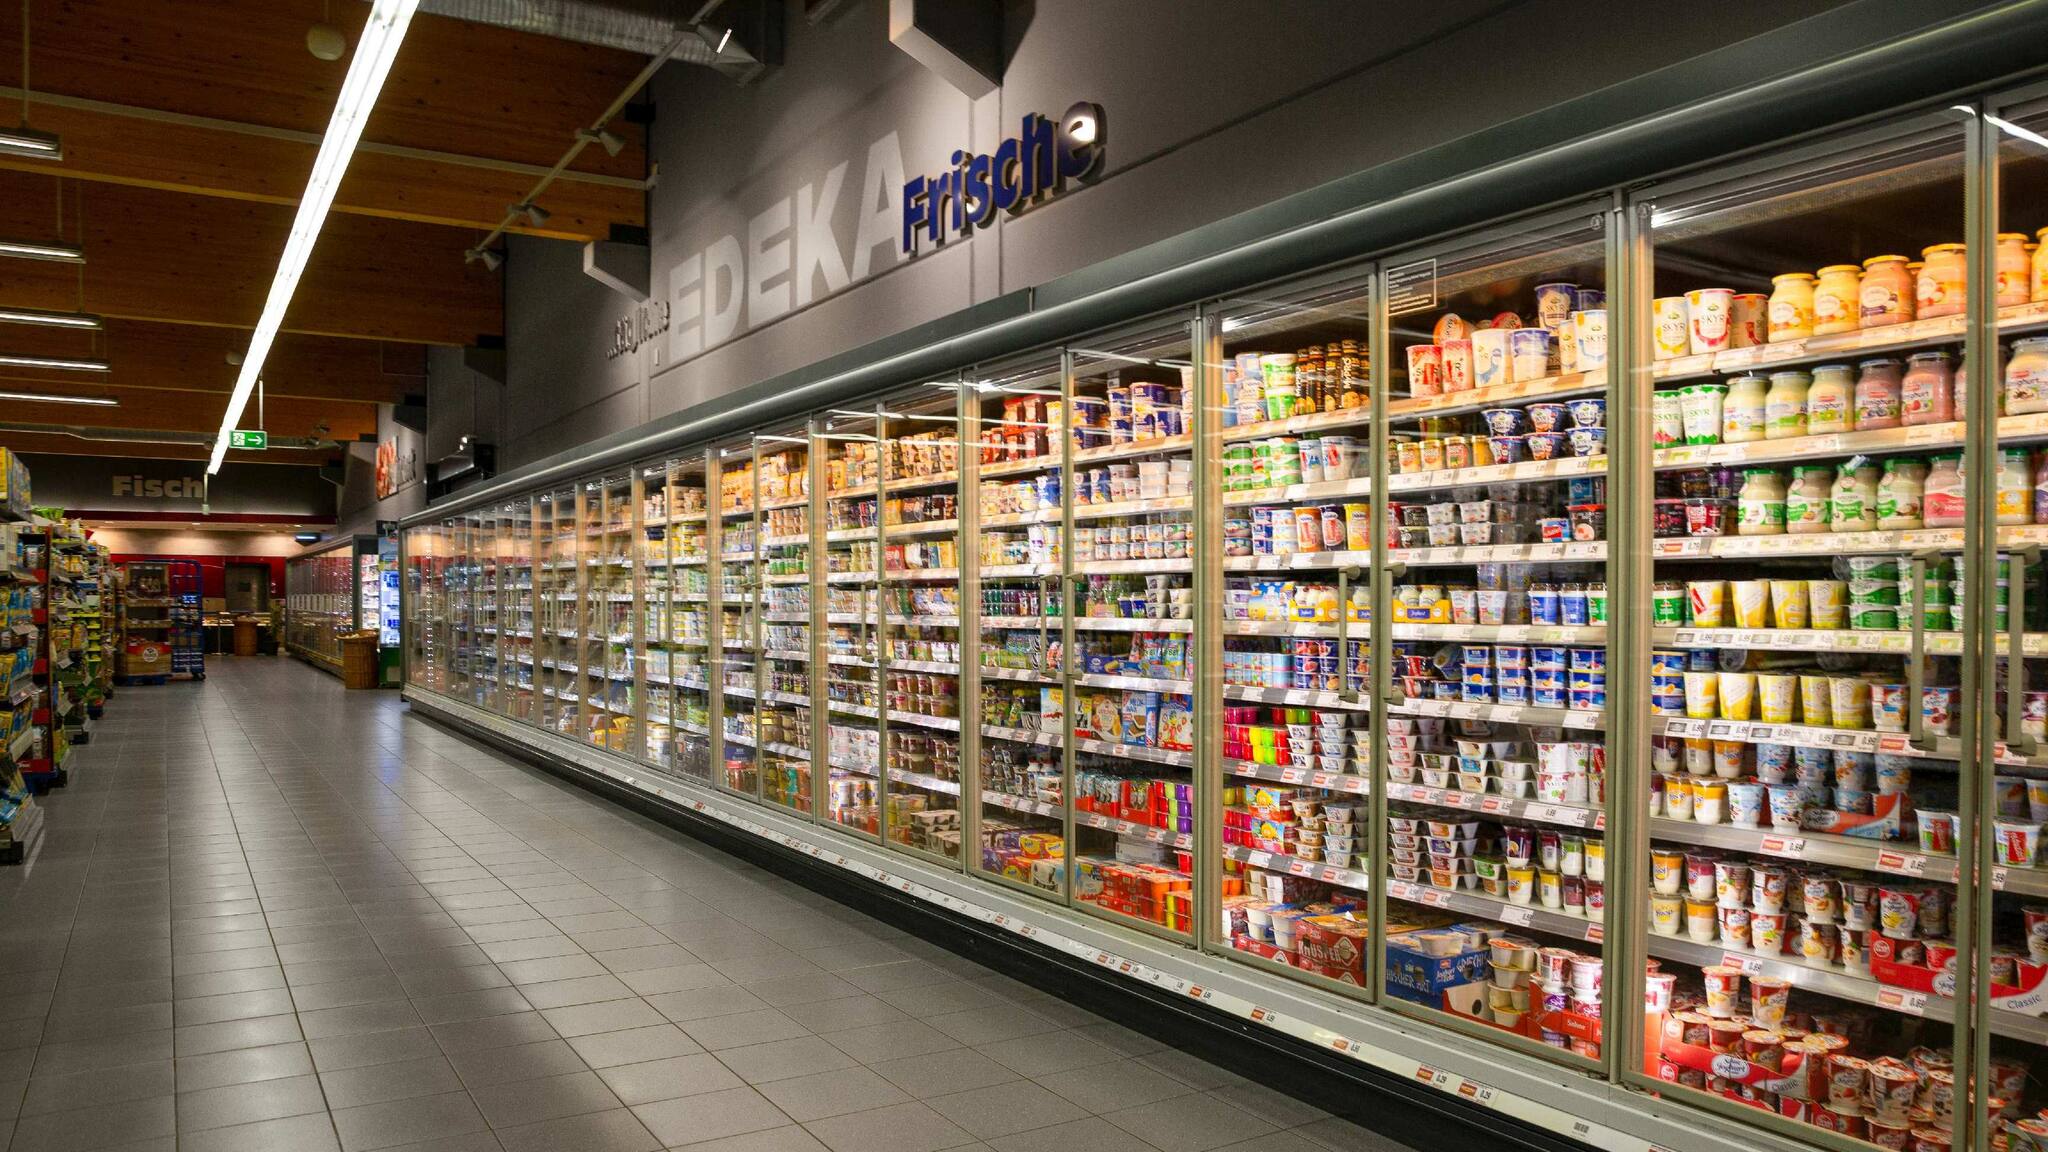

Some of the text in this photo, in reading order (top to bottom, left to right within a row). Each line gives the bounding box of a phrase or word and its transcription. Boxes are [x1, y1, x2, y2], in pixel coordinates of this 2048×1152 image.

[669, 130, 905, 361] EDEKA
[902, 101, 1106, 254] Frische
[111, 475, 204, 498] Fisch
[2007, 993, 2042, 1009] Classic
